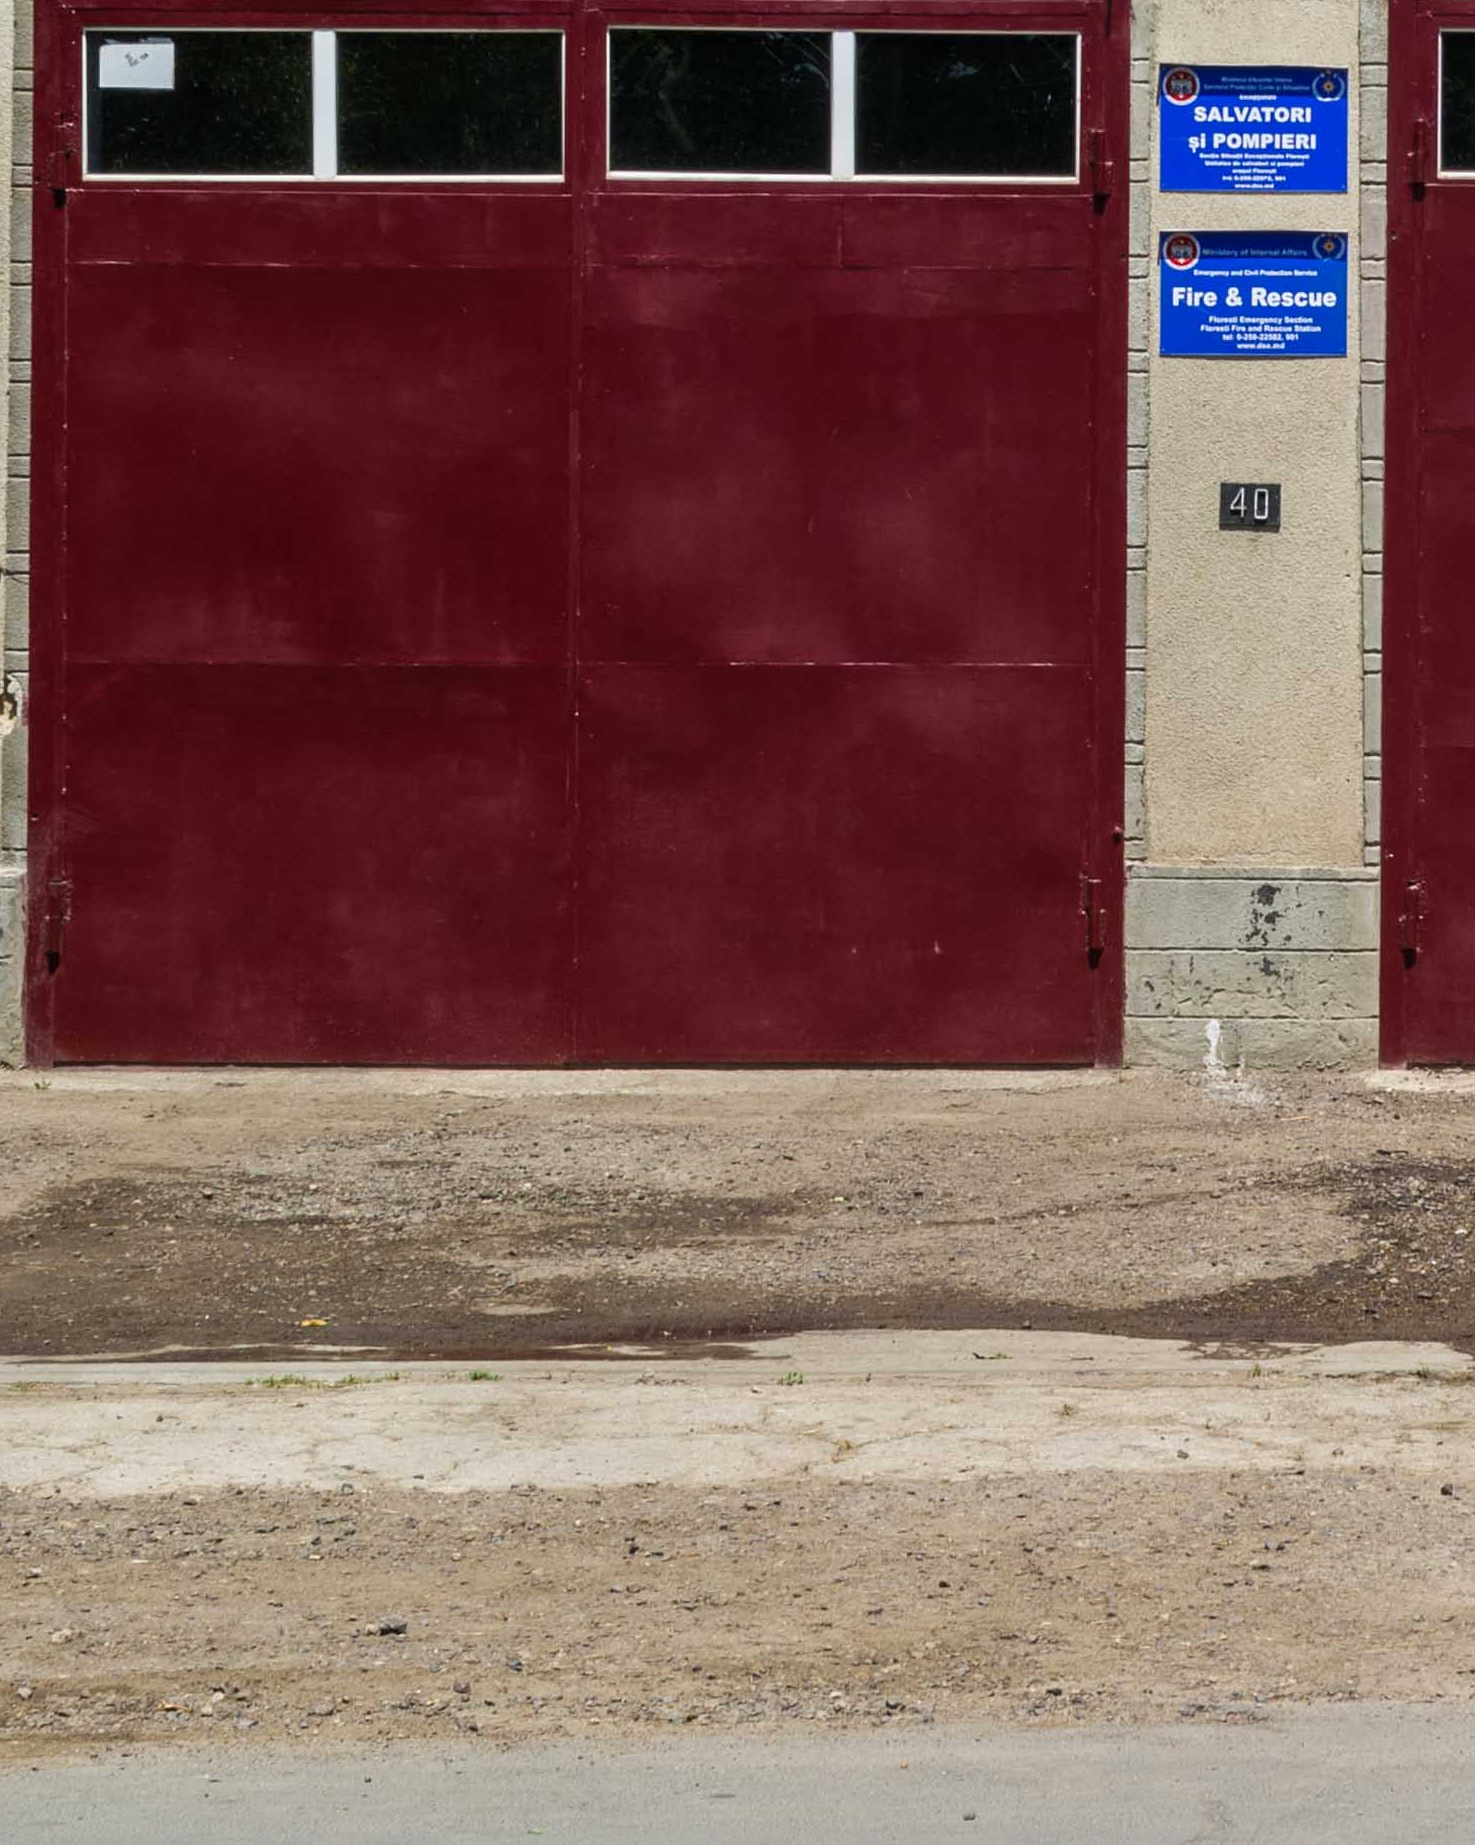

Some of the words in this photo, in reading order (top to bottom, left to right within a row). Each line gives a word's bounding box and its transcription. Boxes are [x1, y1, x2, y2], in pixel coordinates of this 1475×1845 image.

[1193, 106, 1312, 123] SALVATORI
[1213, 133, 1317, 150] POMPIERI
[1172, 287, 1218, 307] Fire
[1225, 287, 1243, 307] &
[1251, 287, 1337, 307] Rescue
[1248, 324, 1262, 332] and
[1230, 487, 1269, 520] 40
